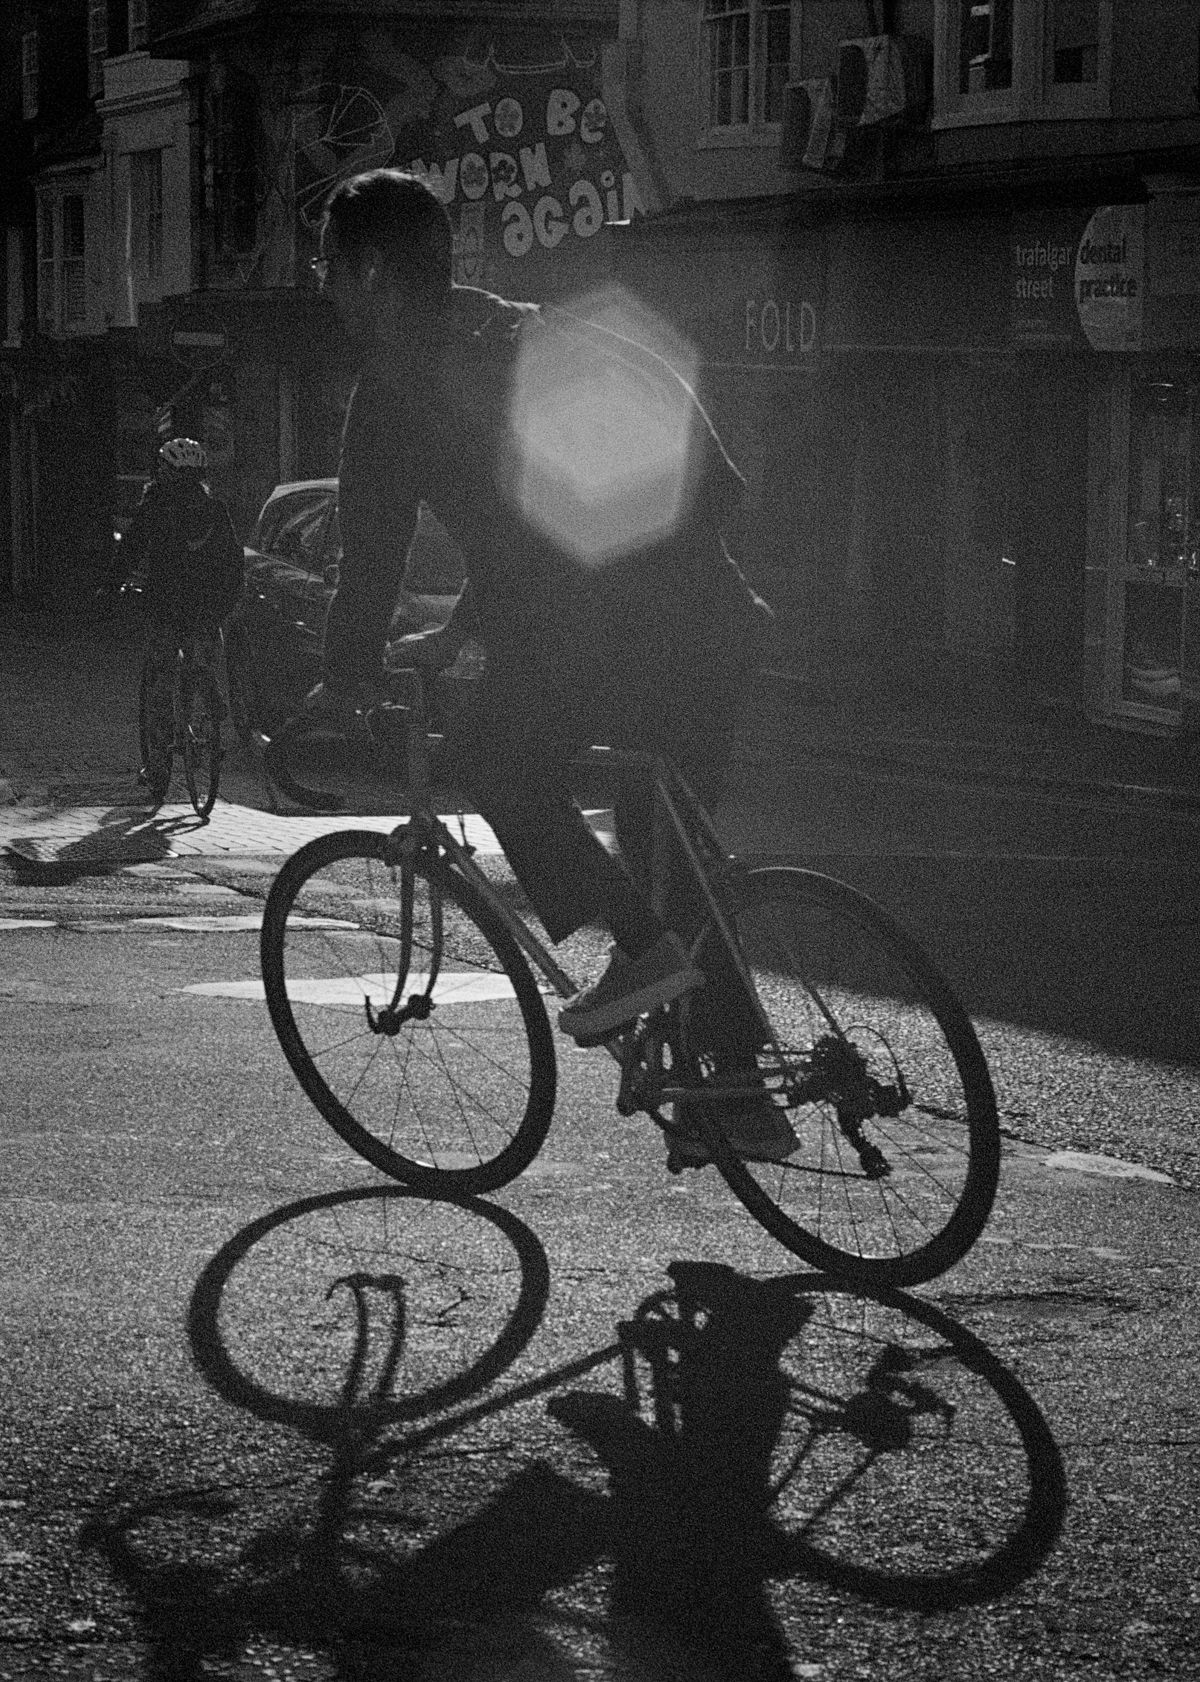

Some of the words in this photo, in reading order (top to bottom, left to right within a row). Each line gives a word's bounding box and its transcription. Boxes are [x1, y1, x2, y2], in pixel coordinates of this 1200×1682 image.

[453, 97, 523, 144] TO
[411, 142, 552, 206] WORN
[1015, 240, 1073, 271] trafalgar
[1080, 239, 1127, 265] dental
[1015, 276, 1055, 299] street
[1079, 273, 1138, 304] practice
[744, 299, 817, 352] FOLD
